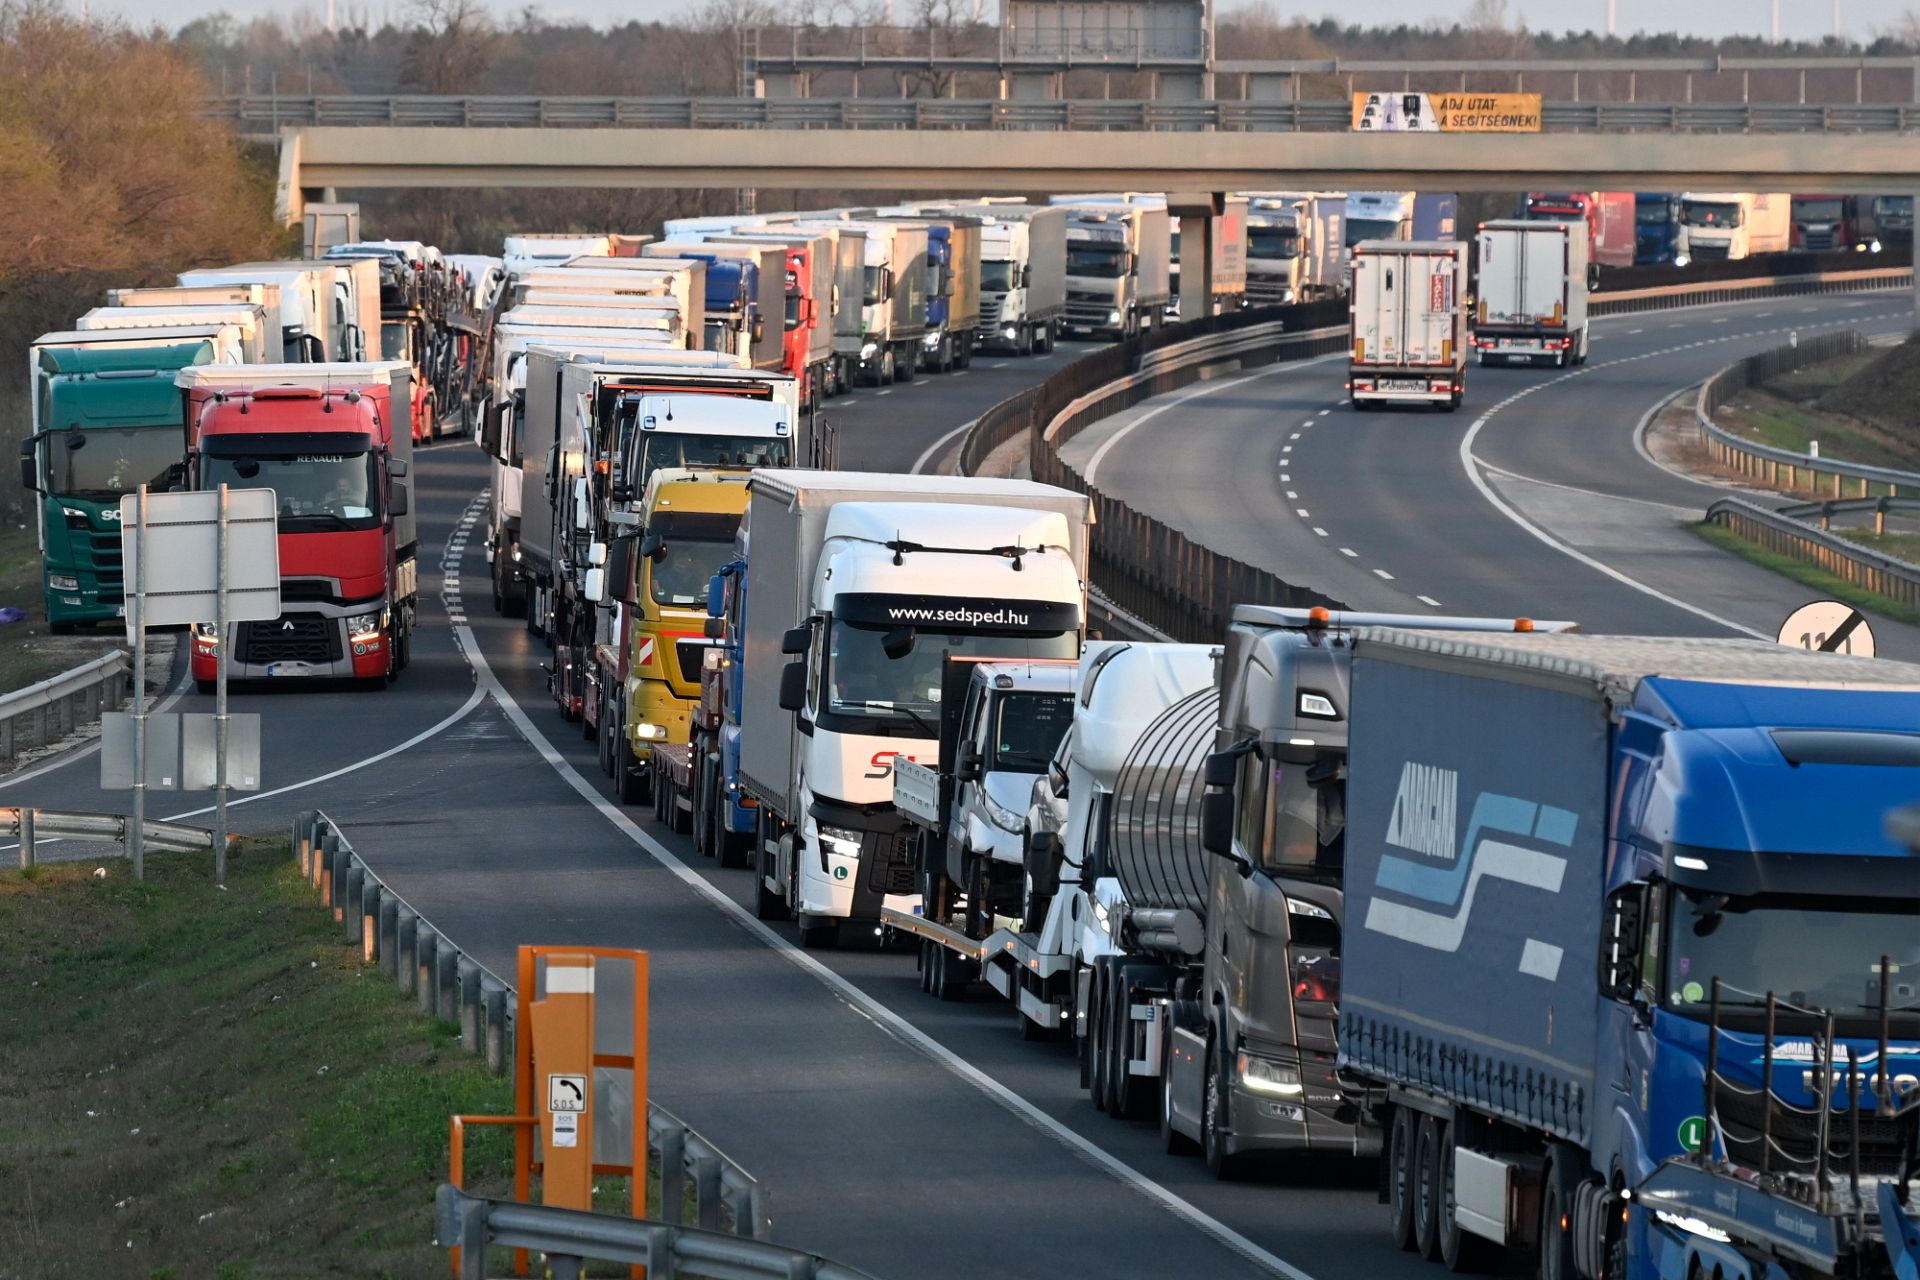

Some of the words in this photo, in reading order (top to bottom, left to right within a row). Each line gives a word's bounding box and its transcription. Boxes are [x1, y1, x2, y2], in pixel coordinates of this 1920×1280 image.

[1440, 98, 1463, 111] ADJ
[1467, 97, 1497, 111] UTAT
[1440, 115, 1448, 127] A
[297, 455, 344, 463] RENAULT
[888, 607, 1029, 626] www.sedsped.hu
